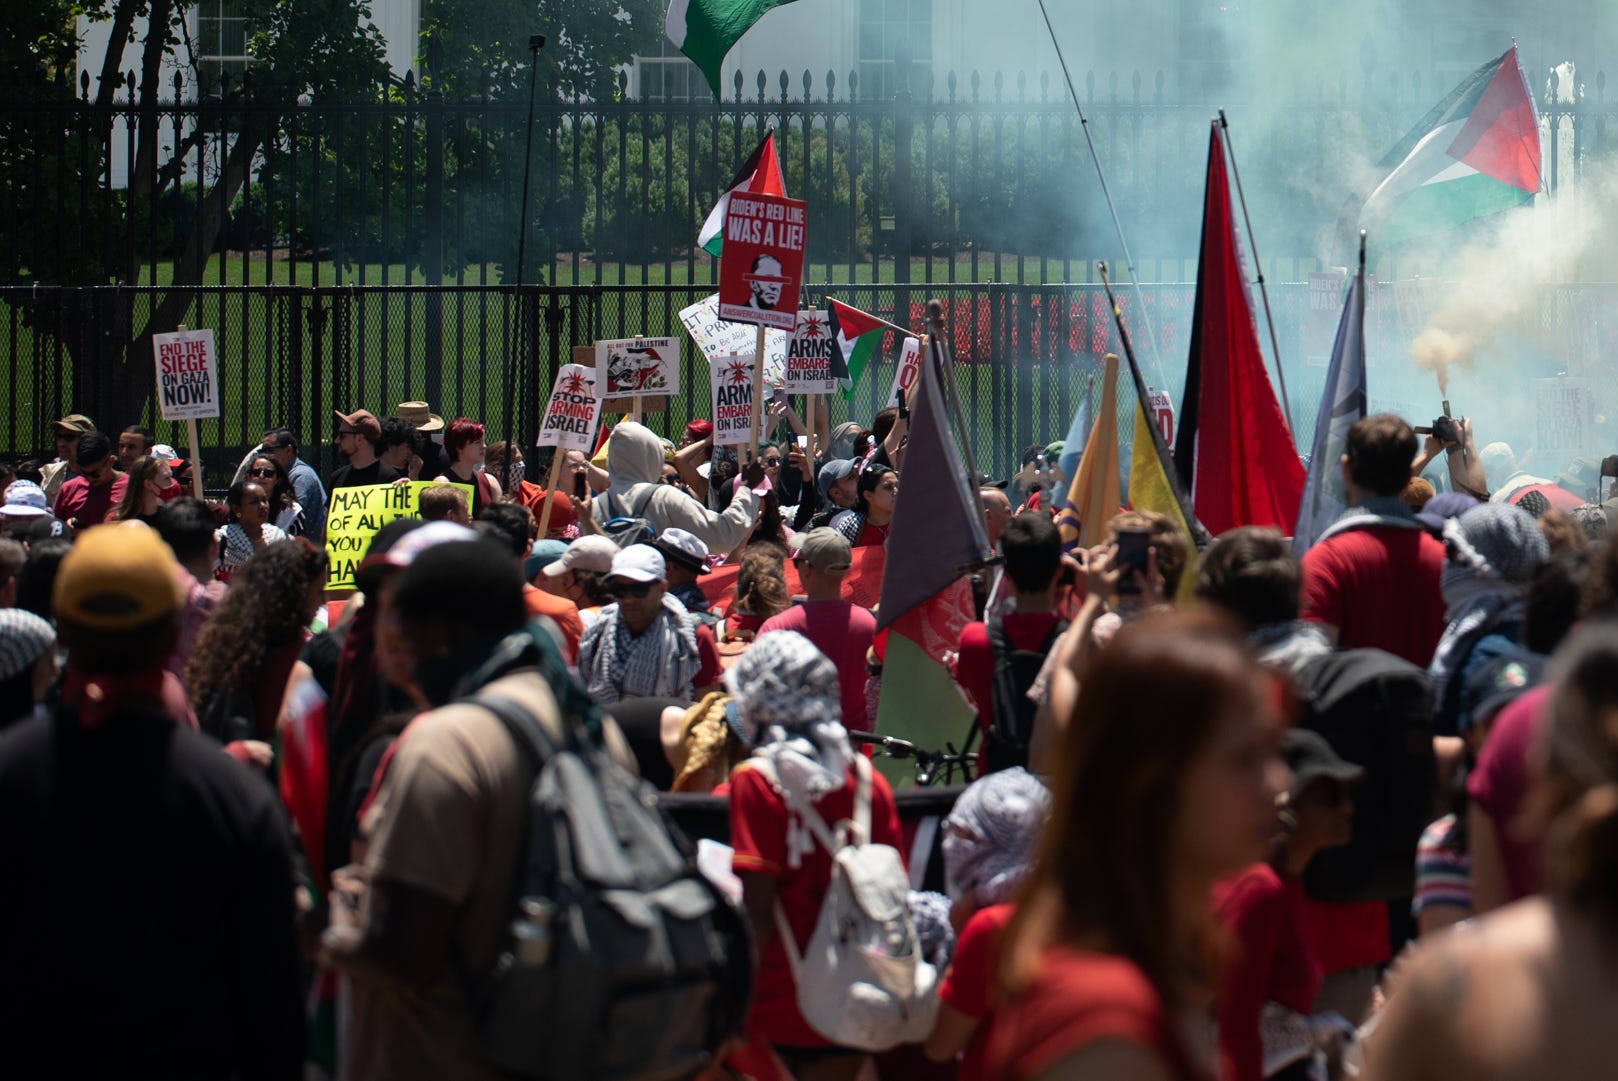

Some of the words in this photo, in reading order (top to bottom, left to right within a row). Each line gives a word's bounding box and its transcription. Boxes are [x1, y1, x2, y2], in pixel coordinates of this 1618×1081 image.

[730, 198, 765, 218] BIDEN'S
[766, 203, 785, 221] RED
[786, 206, 804, 224] LINE
[728, 216, 762, 244] WAS
[763, 221, 775, 246] A
[778, 223, 804, 251] LIE!
[160, 343, 182, 357] END
[184, 340, 206, 354] THE
[635, 340, 669, 348] PALESTINE
[161, 353, 208, 374] SIEGE
[788, 357, 831, 370] EMBARG
[162, 373, 179, 387] ON
[181, 371, 210, 385] GAZA
[787, 369, 801, 381] ON
[164, 382, 212, 407] NOW!
[552, 392, 597, 405] STOP
[717, 384, 753, 407] ARM
[548, 401, 594, 420] ARMING
[544, 415, 589, 435] ISRAEL
[717, 418, 731, 431] ON
[332, 488, 375, 513] MAY
[380, 485, 413, 510] THE
[329, 515, 353, 531] OF
[329, 536, 362, 552] YOU
